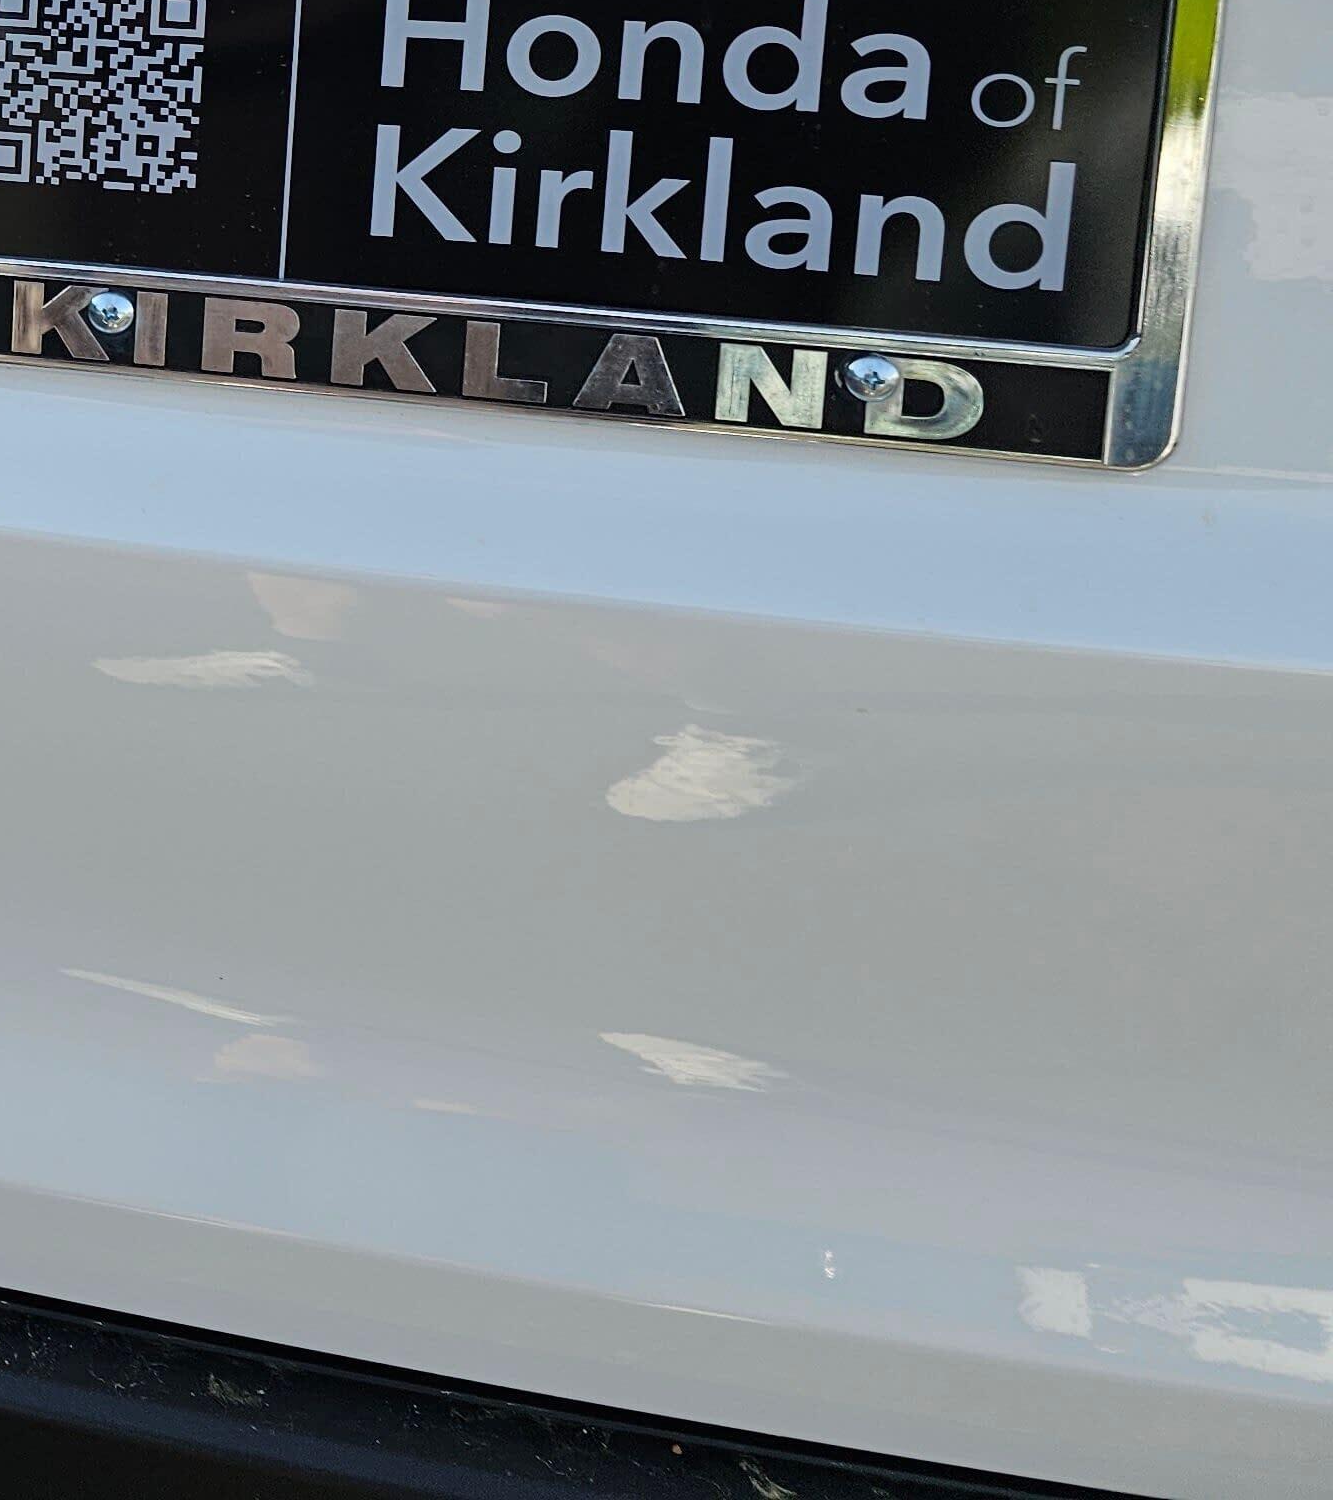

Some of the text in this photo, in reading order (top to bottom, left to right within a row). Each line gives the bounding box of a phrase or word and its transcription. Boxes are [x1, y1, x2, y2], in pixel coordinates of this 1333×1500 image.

[971, 44, 1087, 132] of
[369, 123, 1071, 293] Kirkland
[10, 279, 985, 441] KIRKLAND
